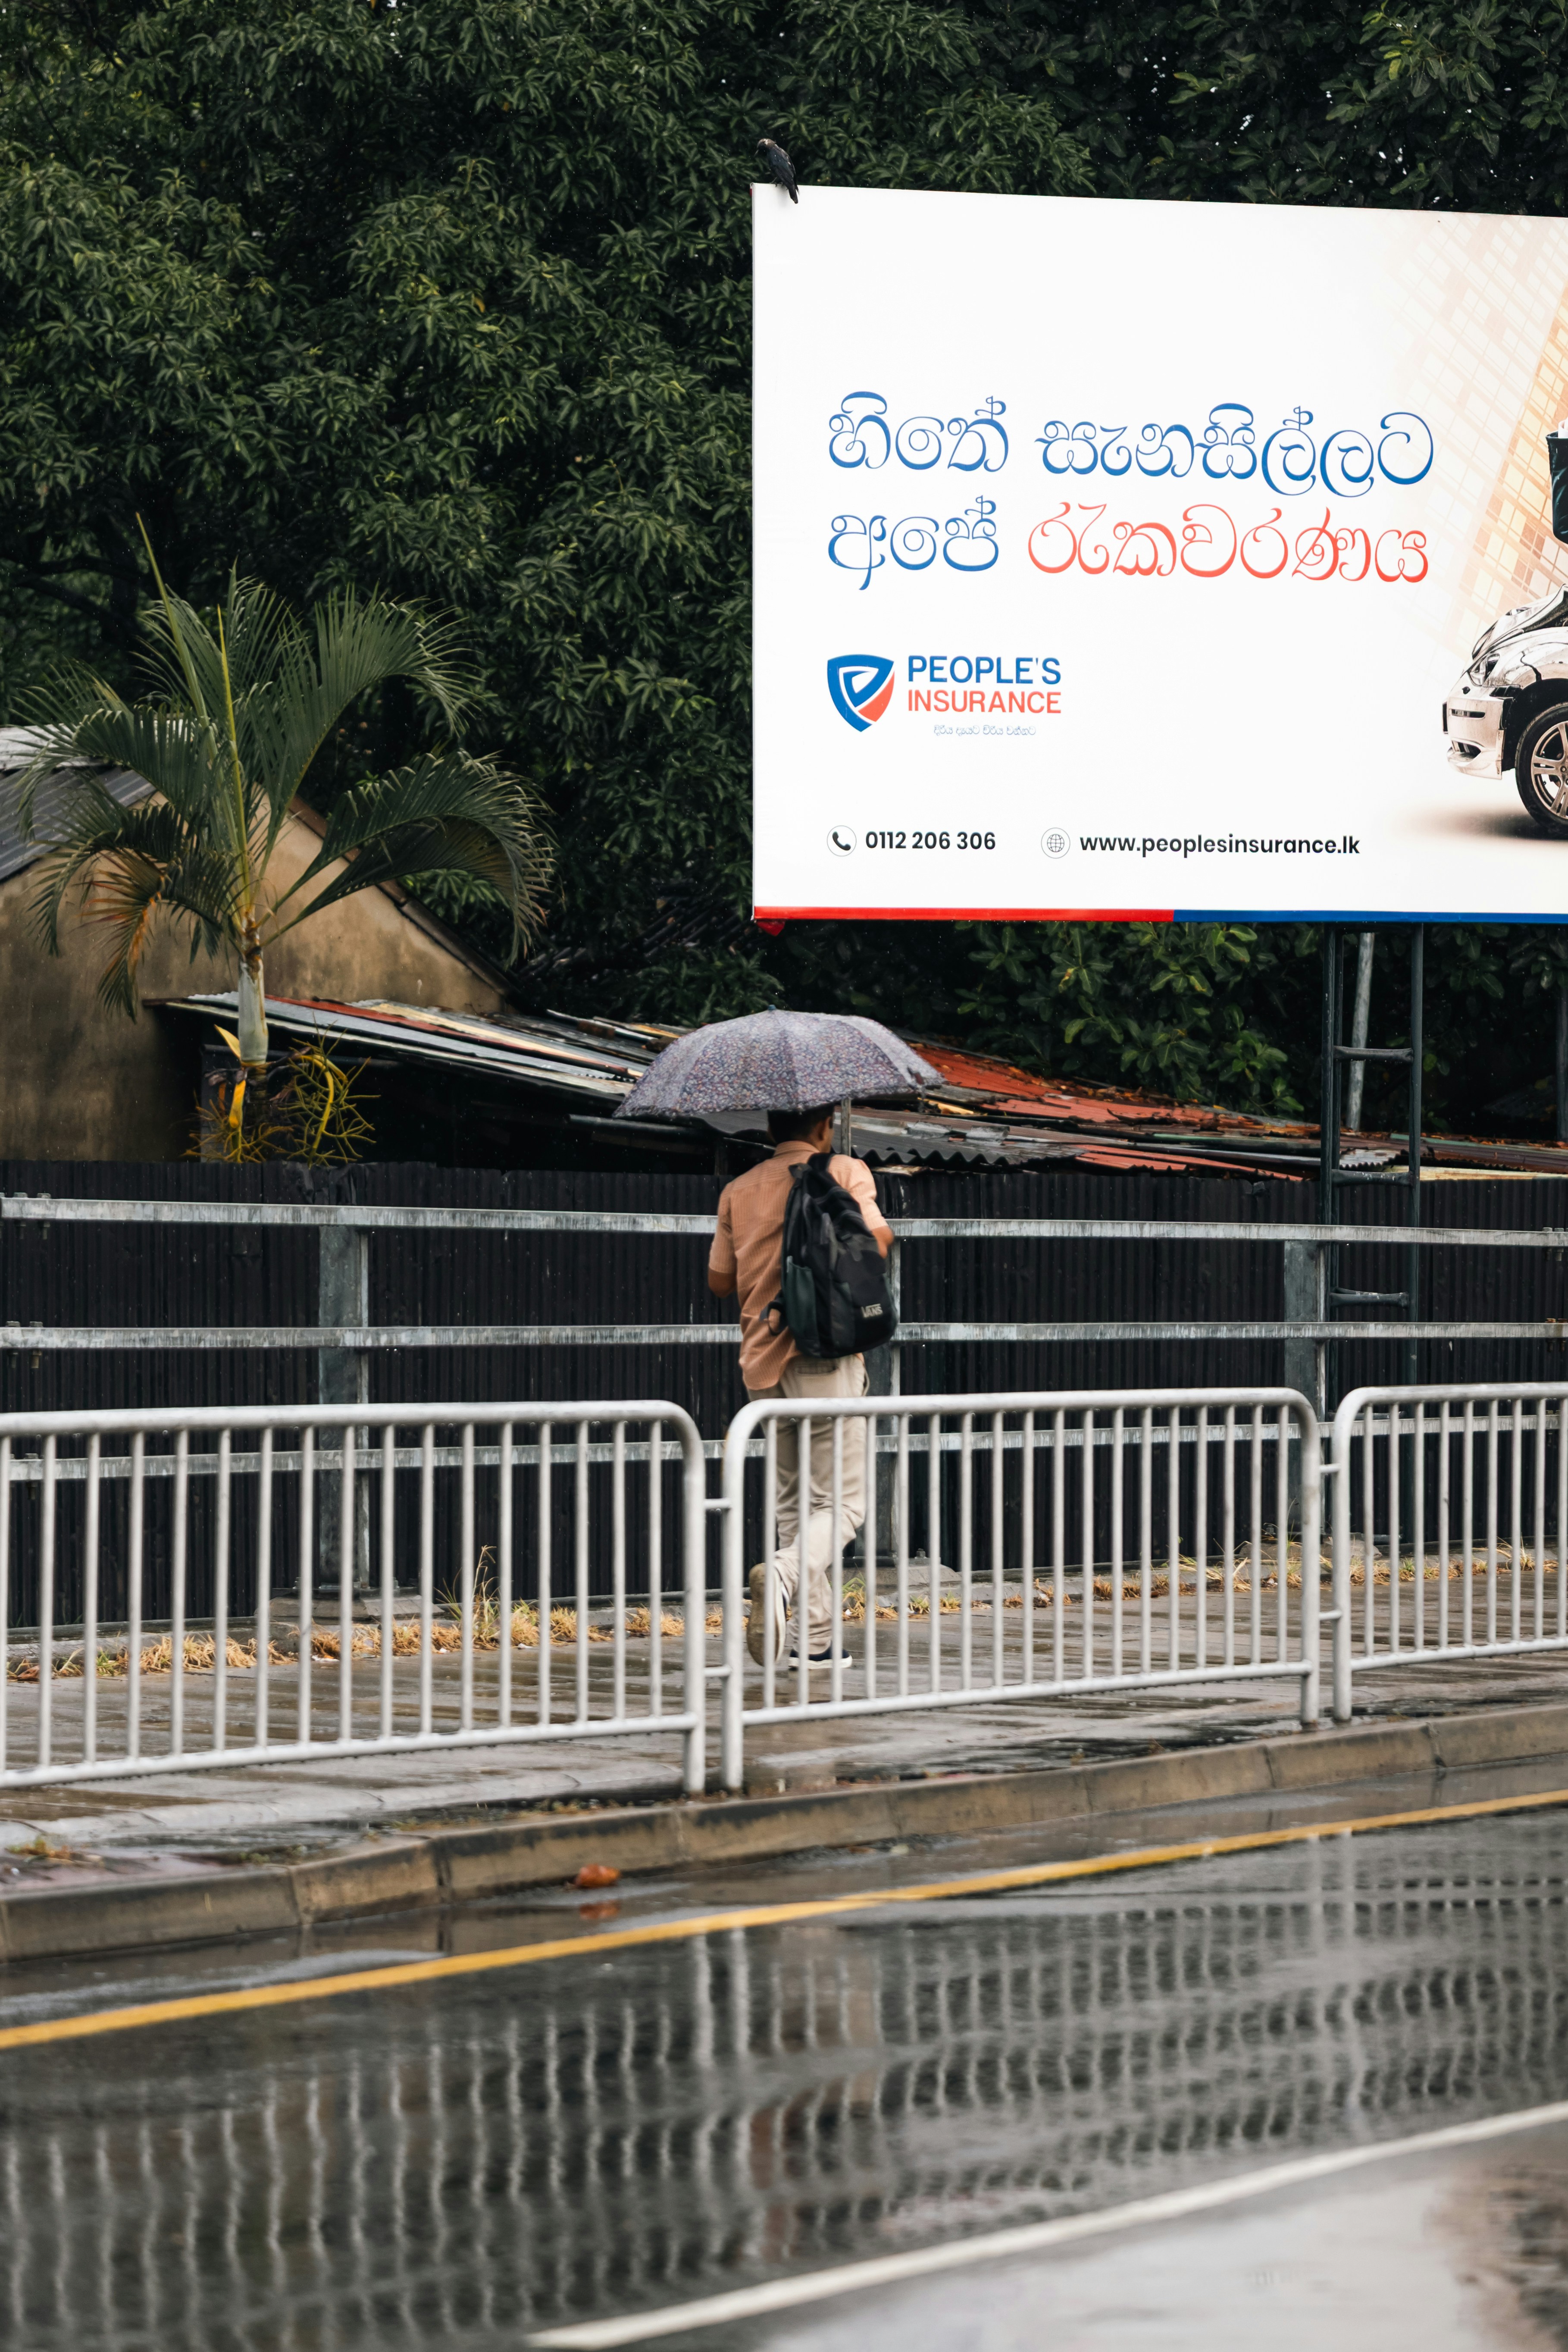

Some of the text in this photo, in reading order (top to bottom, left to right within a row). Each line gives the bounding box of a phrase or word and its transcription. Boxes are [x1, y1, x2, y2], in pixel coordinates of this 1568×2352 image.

[829, 391, 1433, 497] හිතේ සැනසිල්ලට
[828, 495, 1428, 591] අපේ රැකවරණය
[908, 655, 1061, 685] PEOPLE'S
[908, 689, 1061, 714] INSURANCE
[865, 831, 996, 850] 0112 206 306
[1080, 833, 1360, 858] www.peoplesinsurance.lk
[861, 1303, 883, 1318] VANS
